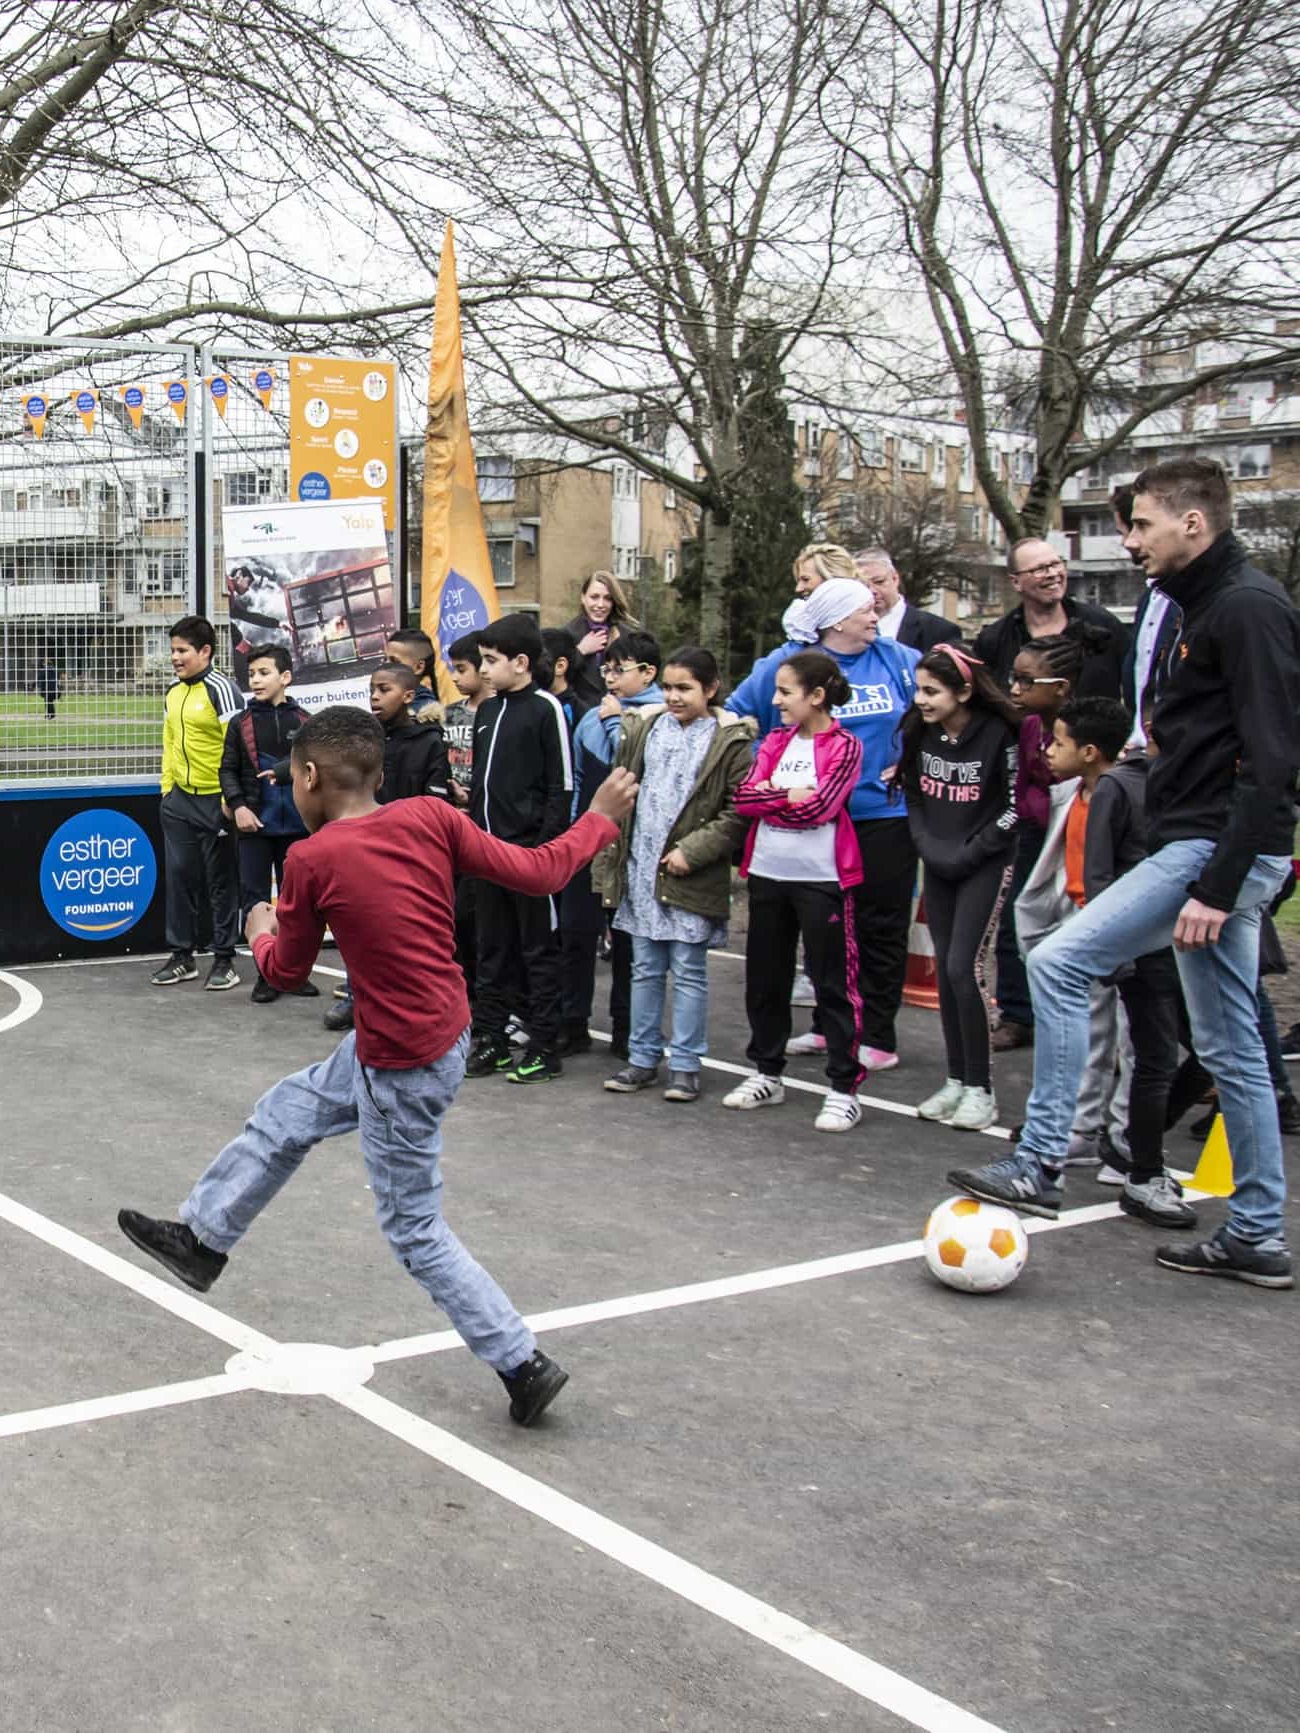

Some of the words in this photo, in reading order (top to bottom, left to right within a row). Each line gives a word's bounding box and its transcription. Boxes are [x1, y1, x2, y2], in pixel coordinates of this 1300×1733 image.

[947, 785, 981, 802] THIS
[59, 833, 137, 862] esther
[52, 865, 145, 895] vergeer
[64, 901, 134, 916] FOUNDATION
